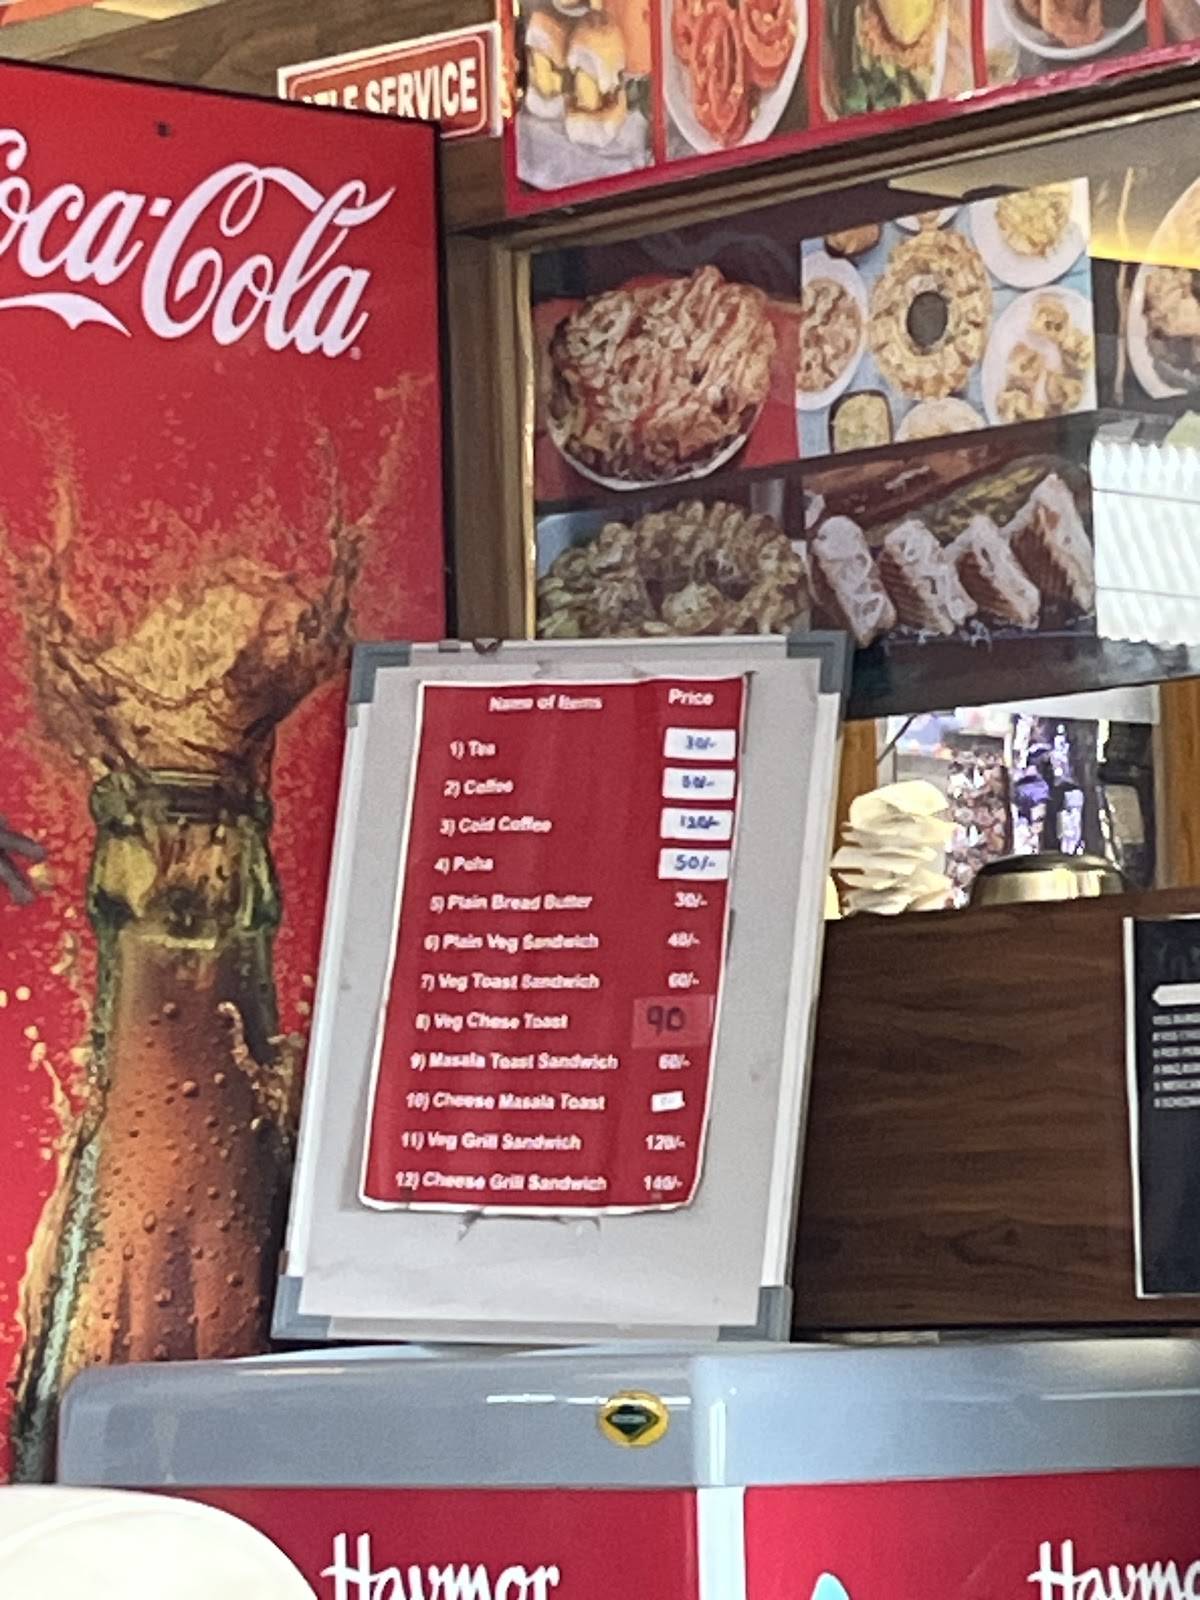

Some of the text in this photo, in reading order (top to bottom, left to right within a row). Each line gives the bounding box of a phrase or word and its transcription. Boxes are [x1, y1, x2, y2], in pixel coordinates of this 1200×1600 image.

[365, 57, 478, 120] SERVICE
[490, 695, 602, 711] Name of Items
[669, 689, 714, 705] Price
[450, 741, 496, 758] 1) Tea
[444, 779, 514, 795] 2) Coffee
[440, 816, 552, 835] 3) Cold Coffee
[435, 857, 449, 873] 4)
[674, 855, 715, 871] 50/-
[448, 895, 487, 910] Plain
[492, 894, 541, 910] Bread
[544, 895, 592, 910] Butter
[675, 893, 707, 908] 30/-
[443, 934, 483, 949] Plain
[487, 935, 518, 953] Veg
[523, 934, 599, 949] Sandwich
[668, 934, 700, 948] 40/-
[421, 973, 600, 991] 7) Veg Toast Sandwich
[434, 1014, 463, 1029] Veg
[524, 1013, 569, 1029] Toast
[646, 1006, 685, 1035] 90
[411, 1053, 618, 1070] 9) Masala Toast Sandwich
[407, 1093, 606, 1111] 10) Cheese Masala Toast
[402, 1134, 581, 1150] 11) Veg Grill Sandwich
[645, 1135, 686, 1150] 120/-
[396, 1172, 607, 1191] 12) Cheese Grill Sandwich
